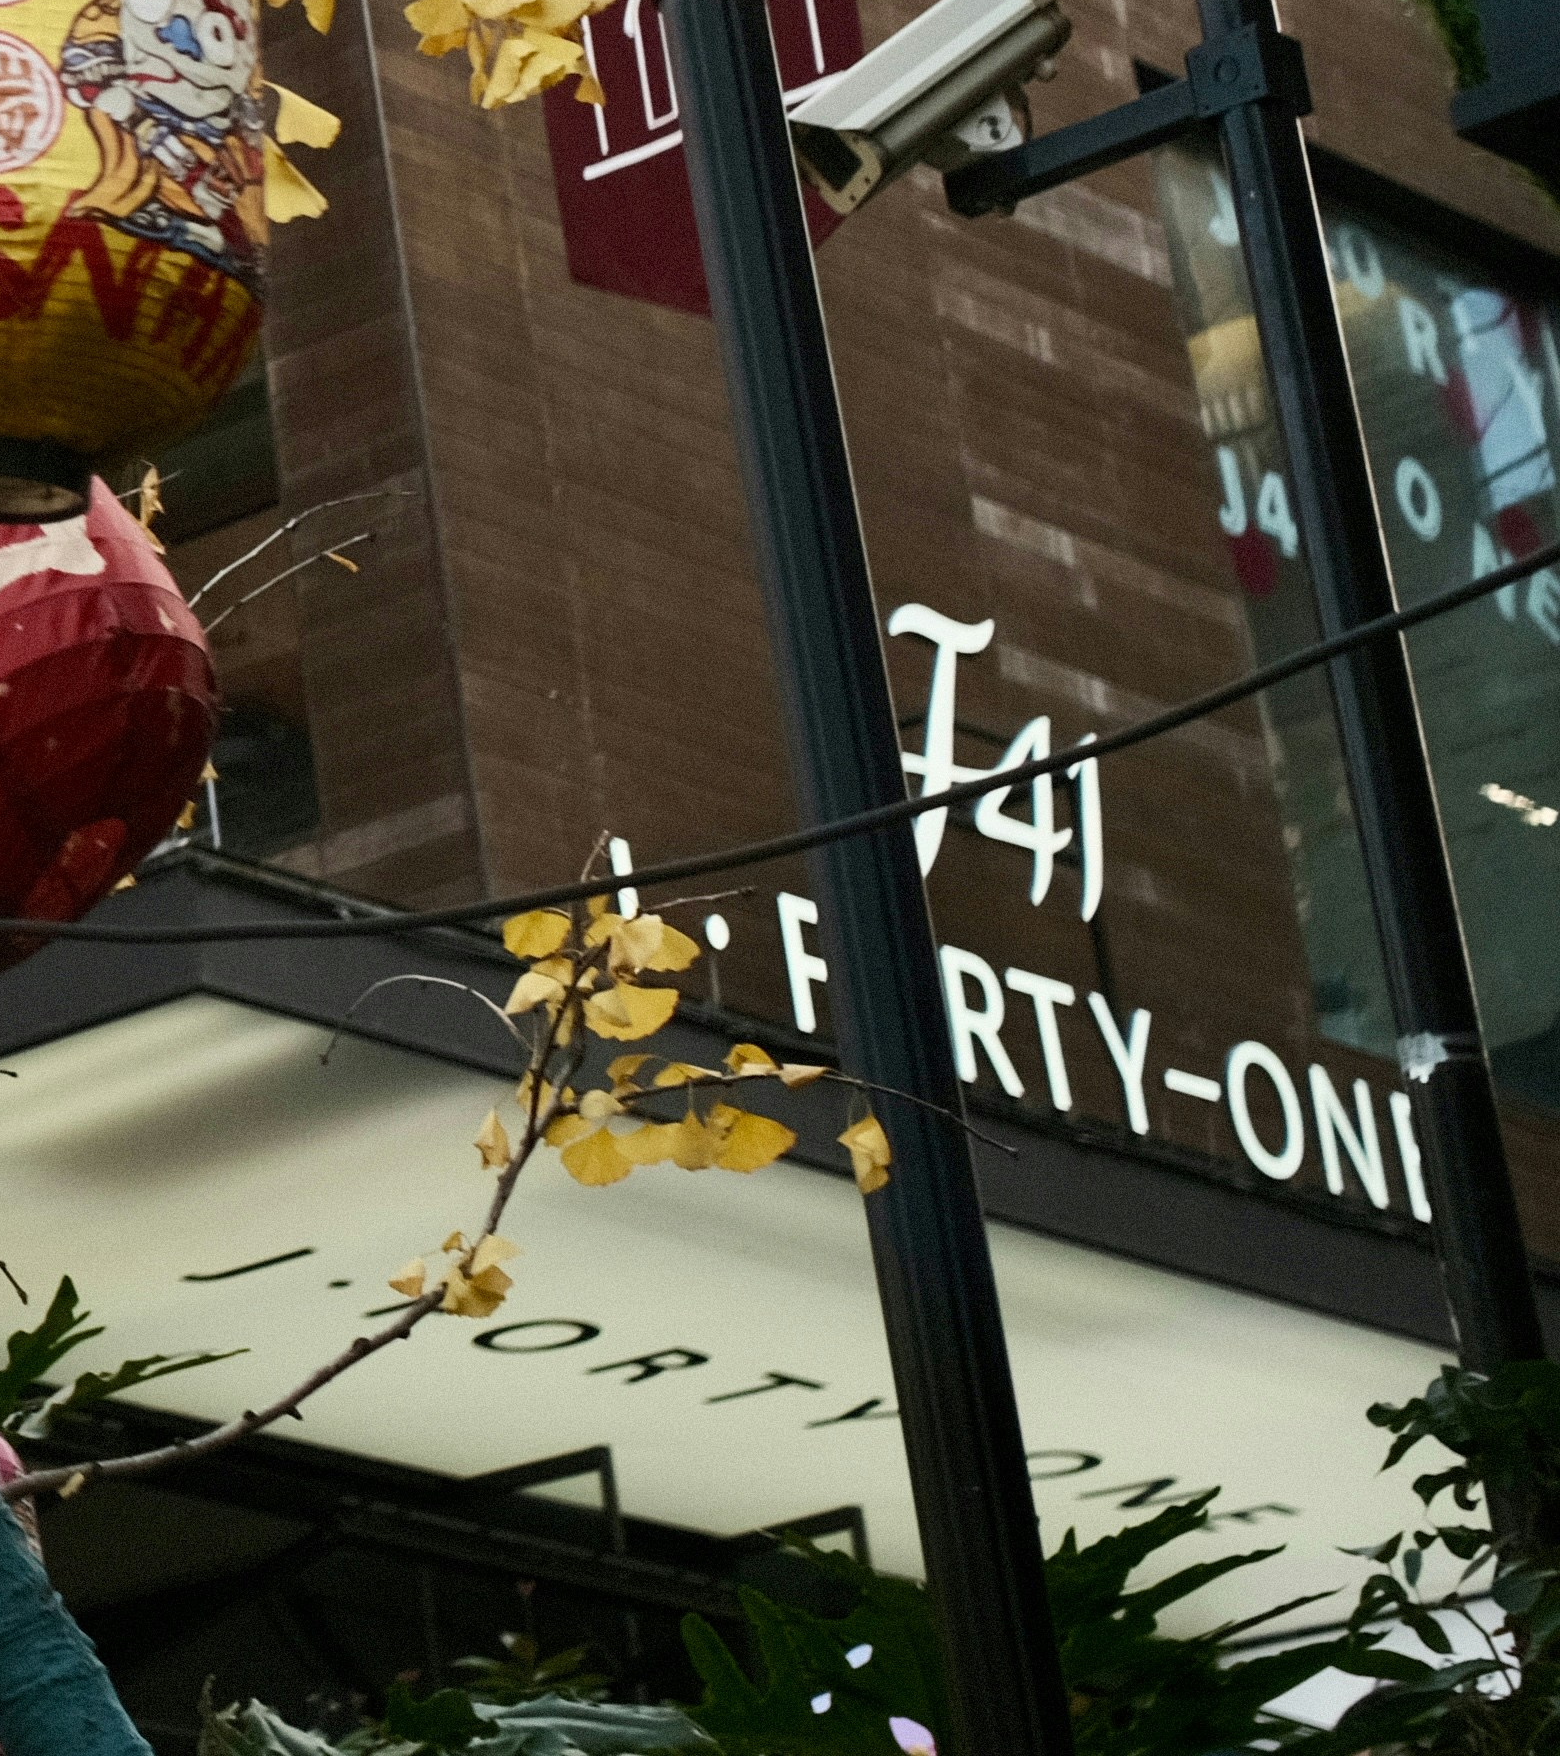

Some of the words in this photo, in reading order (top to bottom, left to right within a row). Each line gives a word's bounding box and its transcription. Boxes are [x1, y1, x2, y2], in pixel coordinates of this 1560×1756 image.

[1218, 446, 1299, 559] J4
[889, 603, 1104, 923] J41
[777, 891, 1433, 1224] FRTY-ON
